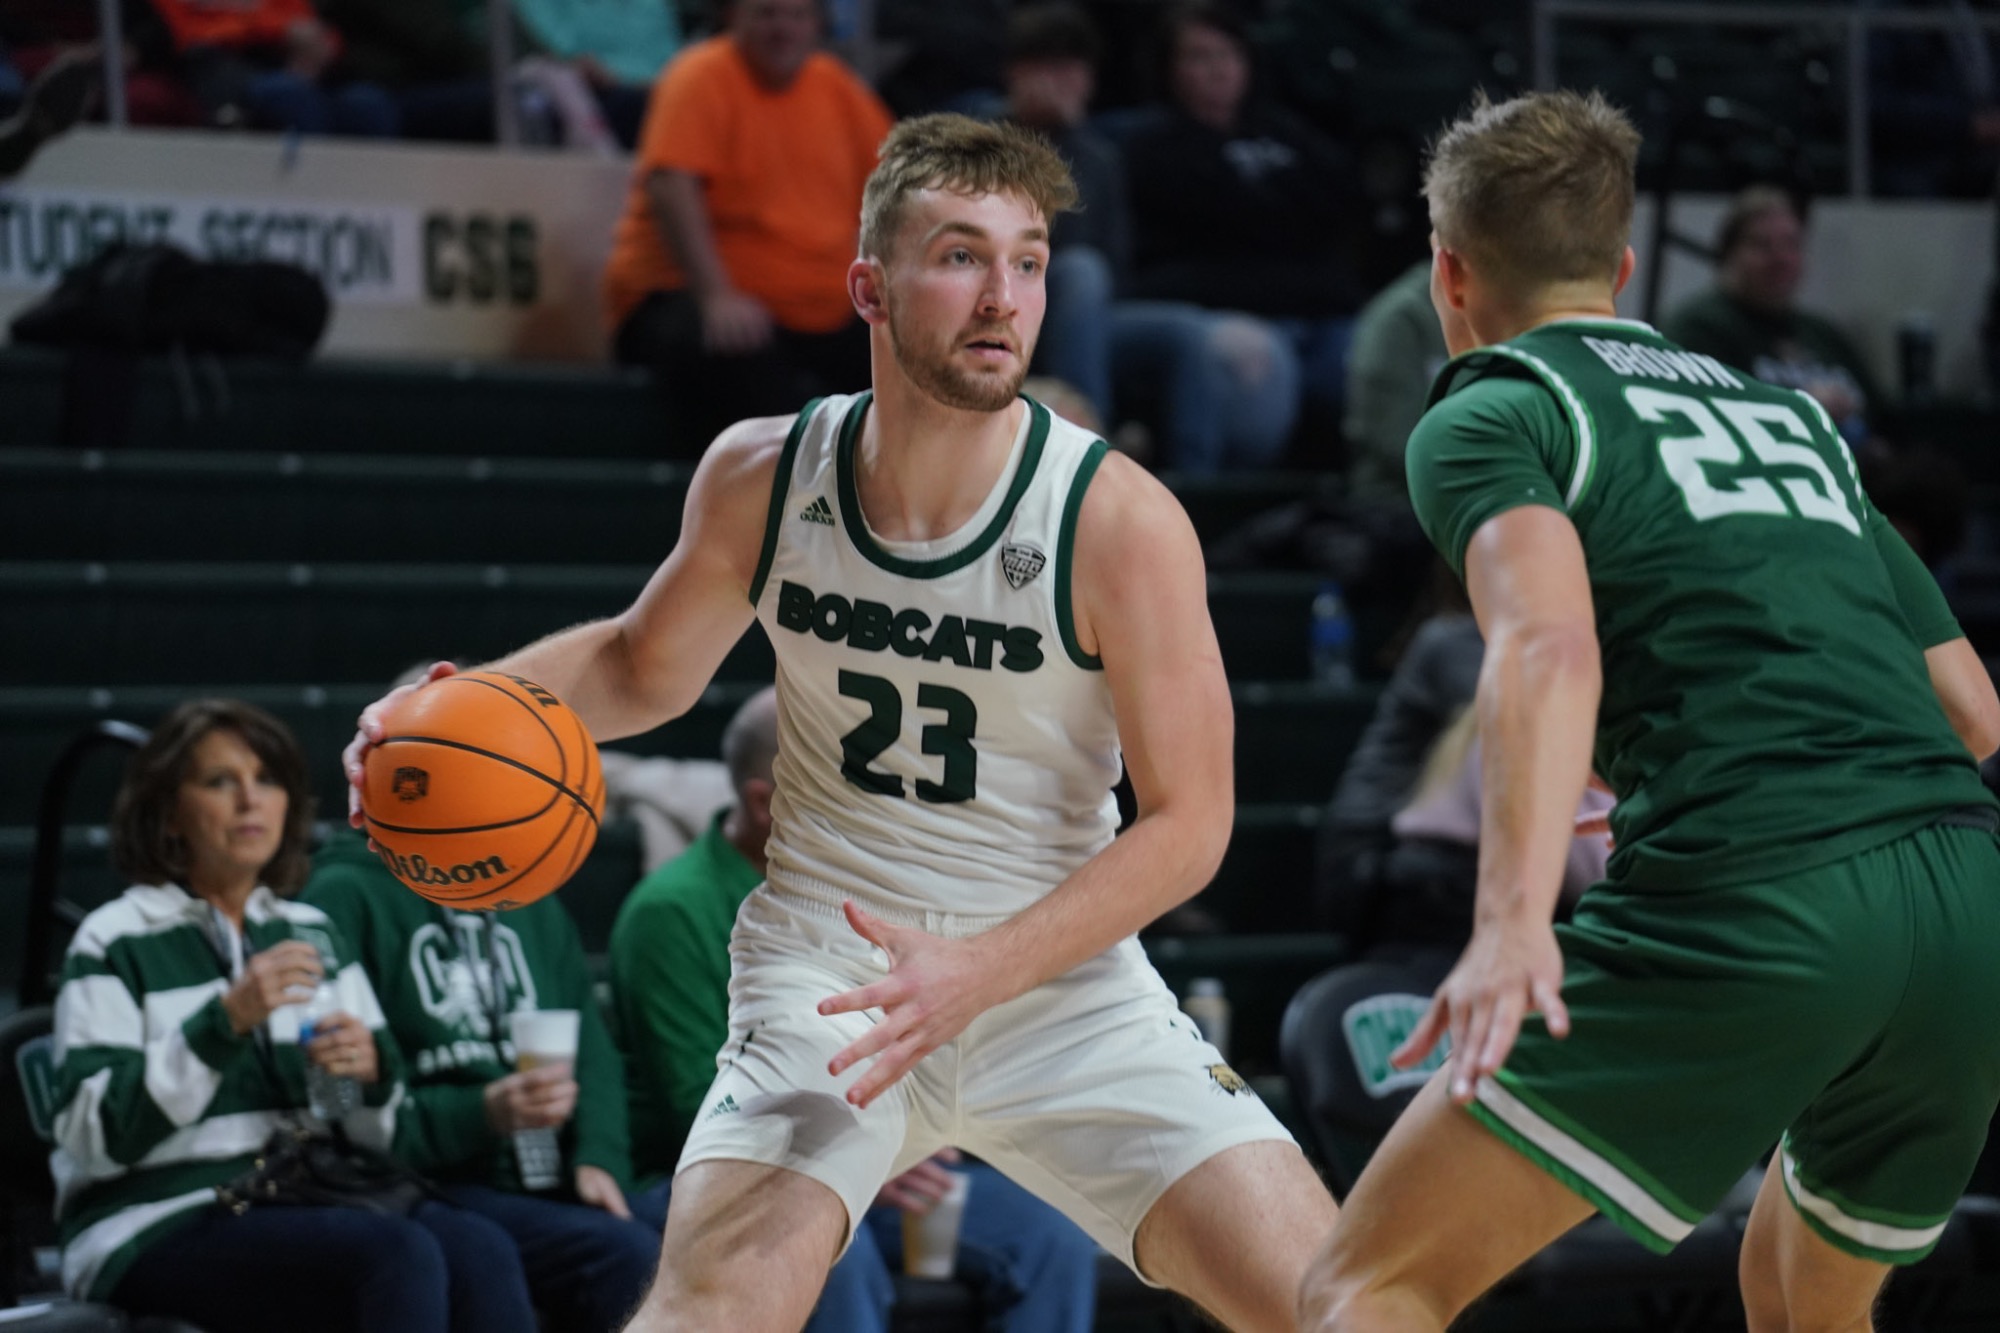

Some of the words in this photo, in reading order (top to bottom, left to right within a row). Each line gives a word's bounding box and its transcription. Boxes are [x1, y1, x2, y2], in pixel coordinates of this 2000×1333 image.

[1580, 336, 1746, 391] BROWN
[1623, 385, 1864, 539] 25
[777, 580, 1044, 673] BOBCATS
[838, 667, 978, 804] 23
